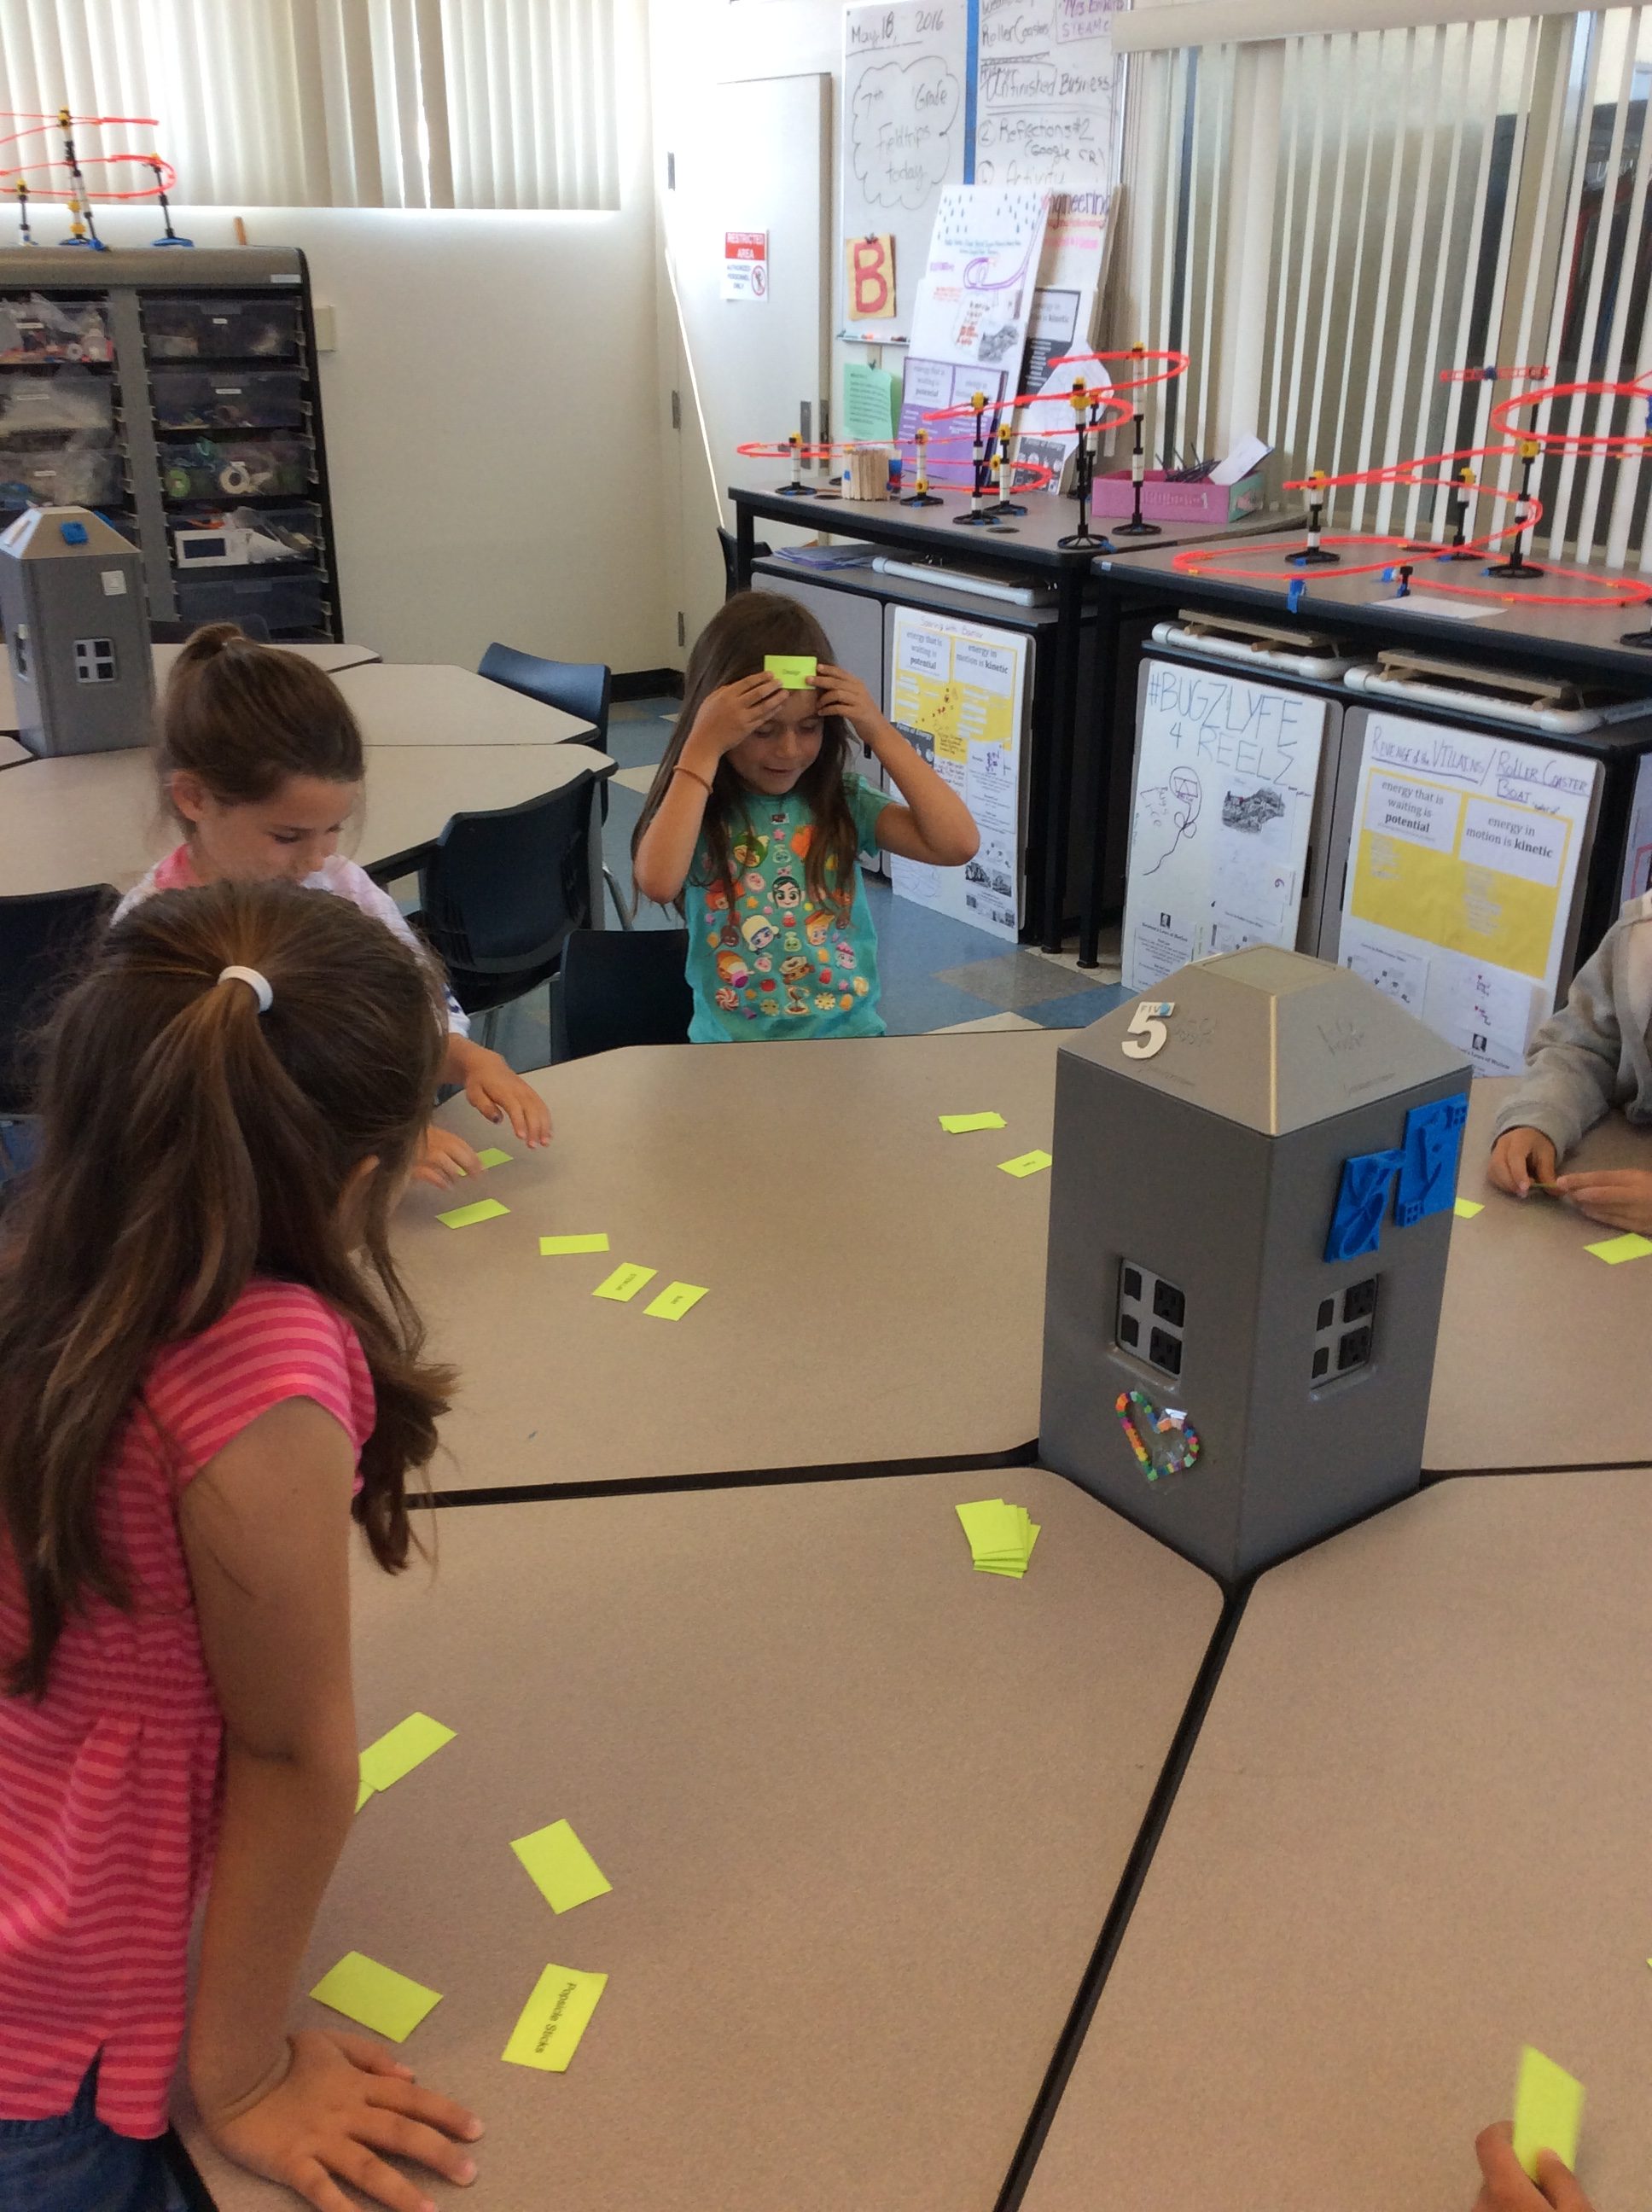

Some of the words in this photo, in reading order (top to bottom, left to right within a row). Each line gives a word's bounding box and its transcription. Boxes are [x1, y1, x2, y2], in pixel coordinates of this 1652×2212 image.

[916, 9, 944, 33] 2016
[736, 247, 754, 259] AREA
[854, 240, 888, 313] B
[910, 656, 937, 669] potential
[985, 660, 1009, 674] kinetic
[1149, 672, 1302, 747] #BUGZLYFE
[1170, 722, 1182, 748] 4
[1382, 780, 1413, 799] energy
[1415, 789, 1435, 803] that
[1435, 795, 1444, 806] is
[1387, 797, 1423, 818] waiting
[1423, 806, 1433, 818] is
[1384, 812, 1431, 834] potential
[1487, 817, 1524, 836] energy
[1525, 825, 1536, 837] in
[1466, 826, 1502, 845] motion
[1503, 835, 1512, 847] is
[1514, 836, 1554, 859] kinetic
[1121, 1002, 1175, 1059] 5
[550, 1981, 578, 2022] Popsicle
[535, 2023, 557, 2053] Sticks
